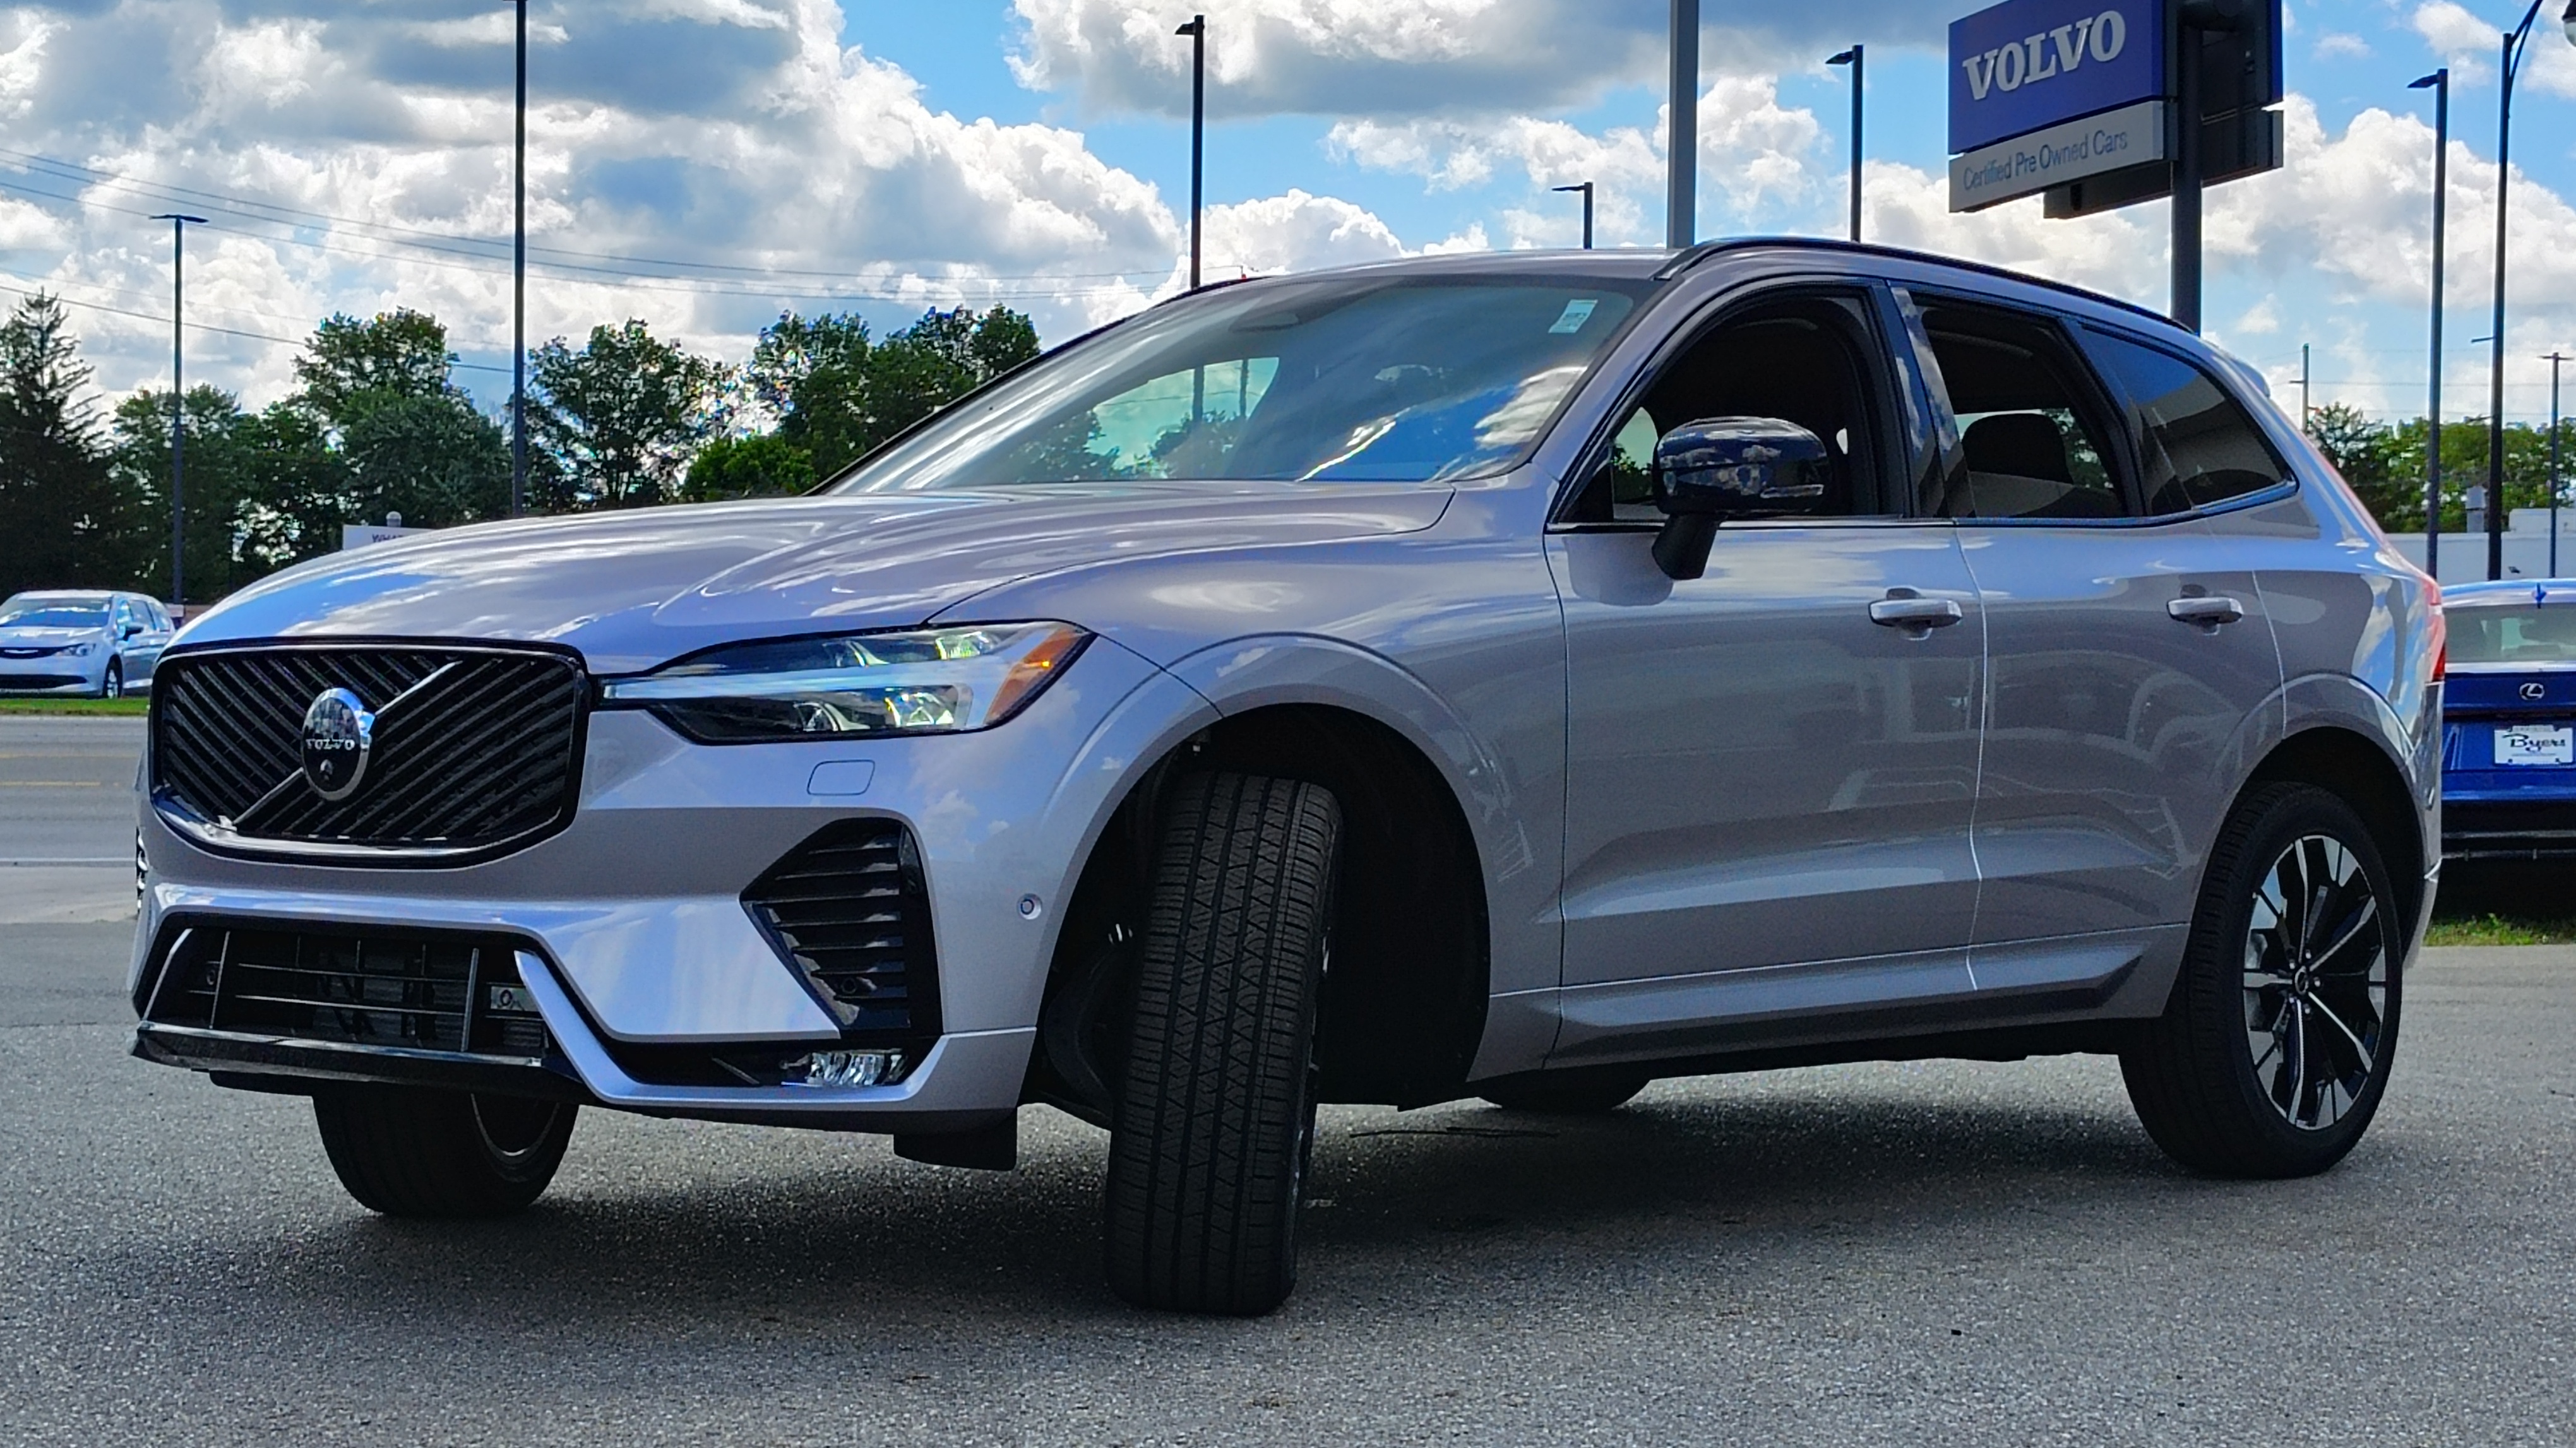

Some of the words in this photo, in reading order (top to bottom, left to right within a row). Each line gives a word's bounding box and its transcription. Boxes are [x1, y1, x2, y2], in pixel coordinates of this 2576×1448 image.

[1962, 11, 2125, 100] VOLVO
[1964, 155, 2012, 190] Certified
[2015, 151, 2037, 177] Pre
[2039, 133, 2089, 169] Owned
[2093, 129, 2128, 155] Cars
[306, 739, 355, 751] VOLVO
